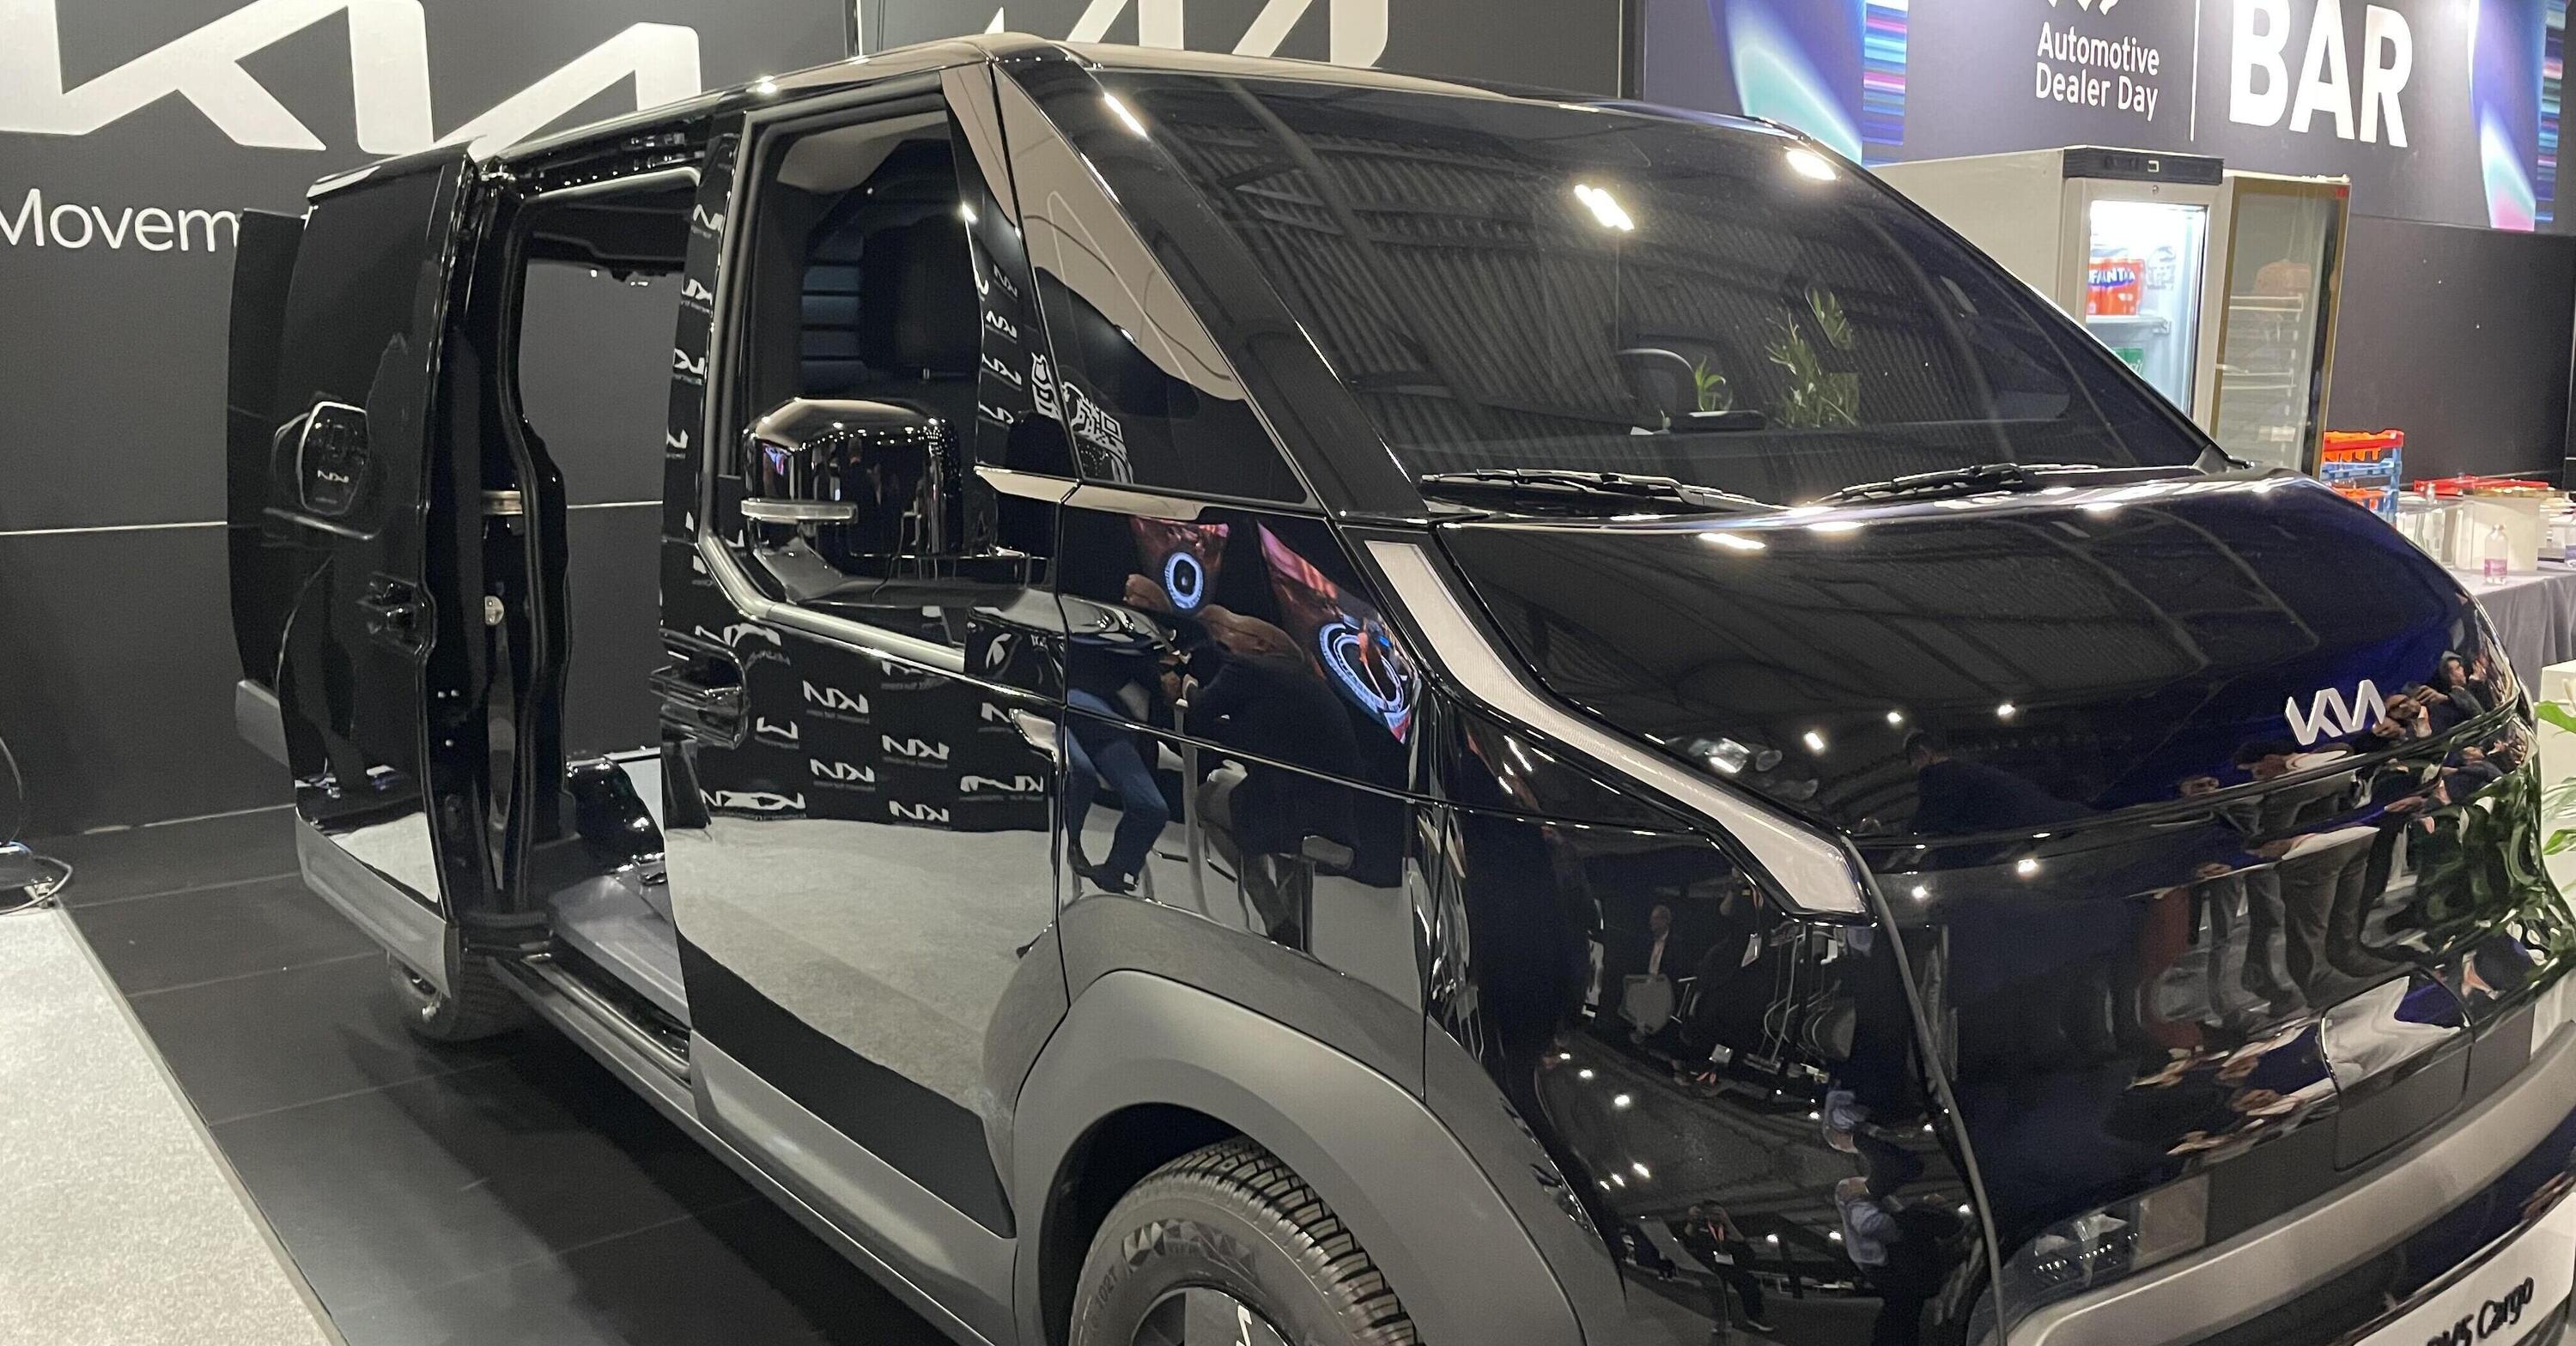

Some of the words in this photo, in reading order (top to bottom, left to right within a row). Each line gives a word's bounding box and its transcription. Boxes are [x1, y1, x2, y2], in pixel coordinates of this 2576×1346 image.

[2037, 21, 2160, 76] Automotive
[2229, 0, 2414, 148] BAR
[2036, 62, 2111, 107] Dealer
[2117, 76, 2159, 122] Day
[0, 188, 240, 252] Movem
[2089, 267, 2136, 284] FANTA
[2285, 679, 2386, 745] KIA
[2477, 1276, 2534, 1339] Cargo
